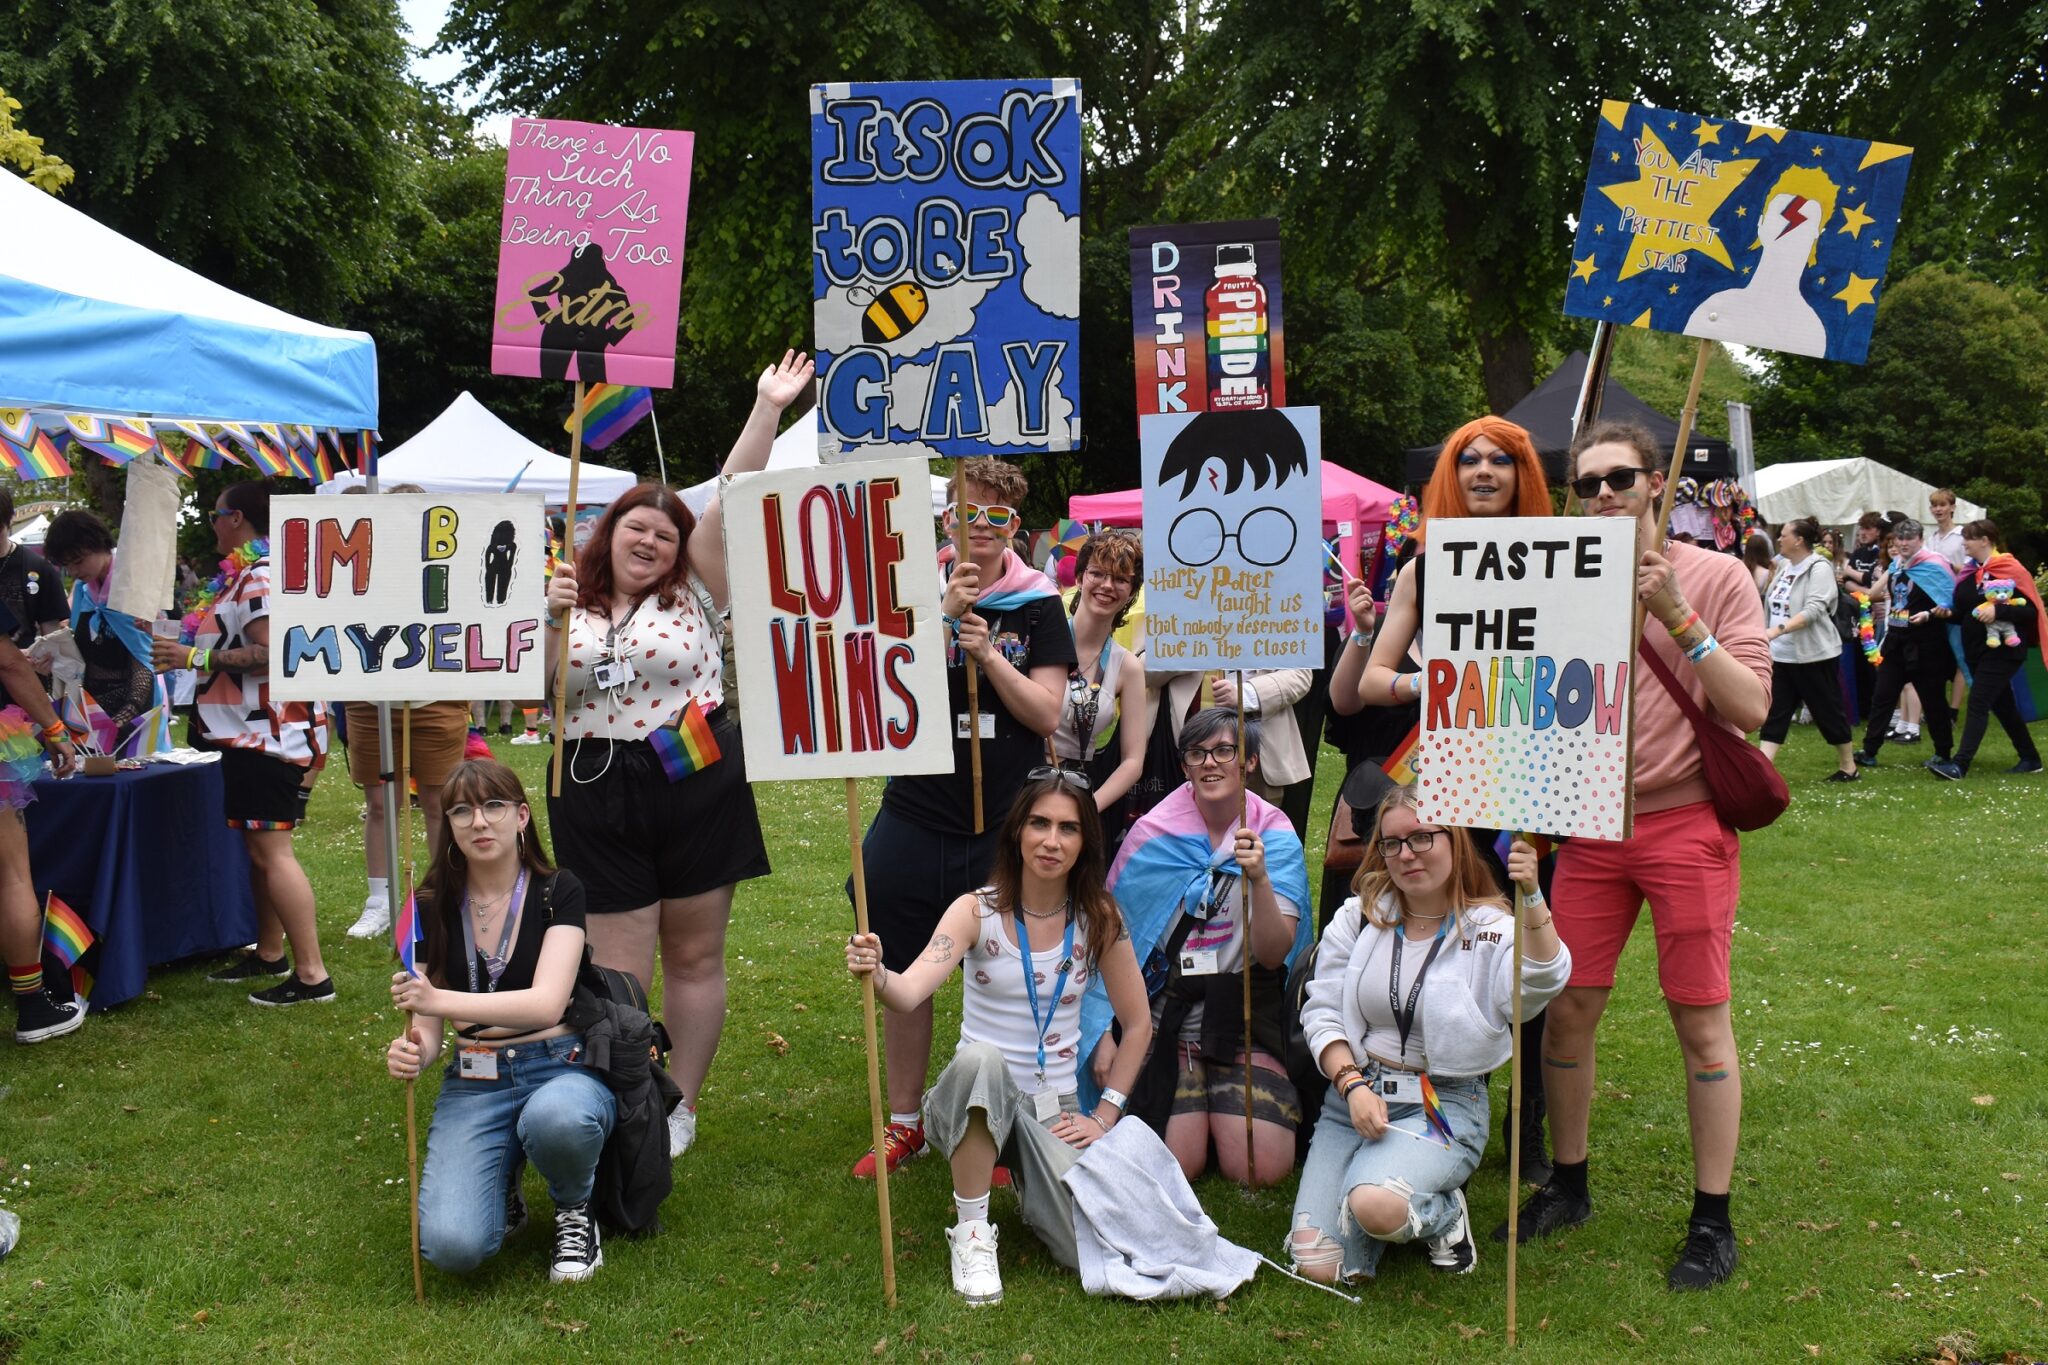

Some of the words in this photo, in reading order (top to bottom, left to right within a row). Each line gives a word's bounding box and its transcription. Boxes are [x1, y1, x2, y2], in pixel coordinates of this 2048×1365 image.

[515, 122, 608, 155] There's
[611, 132, 672, 164] No
[951, 88, 1067, 191] OK
[1633, 138, 1672, 170] YOU
[1678, 148, 1722, 179] ARE
[547, 151, 635, 189] Such
[1651, 175, 1699, 207] THE
[506, 176, 592, 219] Thing
[596, 189, 661, 225] As
[501, 216, 592, 258] Being
[604, 228, 673, 266] Too
[812, 208, 911, 288] to
[913, 195, 1017, 289] BE
[1618, 205, 1720, 244] PRETTIEST
[1638, 248, 1688, 273] STAR
[497, 271, 655, 332] Extra
[1223, 281, 1250, 290] FRUITY
[1151, 241, 1188, 413] DRINK
[1218, 291, 1258, 396] PRIDE
[821, 340, 1068, 444] GAY
[281, 517, 373, 598] IM
[421, 505, 459, 614] BI
[762, 476, 914, 640] LOVE
[1442, 536, 1603, 581] TASTE
[1149, 567, 1206, 600] Harry
[1210, 565, 1275, 604] Potter
[1217, 591, 1271, 620] taught
[1280, 593, 1302, 612] us
[283, 618, 539, 678] MYSELF
[1146, 613, 1178, 636] that
[1183, 615, 1233, 640] nobody
[1236, 615, 1299, 635] deserves
[1304, 617, 1319, 633] to
[1192, 640, 1208, 657] in
[1216, 636, 1242, 659] the
[1435, 607, 1537, 651] THE
[1426, 655, 1628, 735] RAINBOW
[469, 961, 478, 991] STUDENT
[1392, 962, 1400, 993] Canterbury
[1407, 982, 1421, 1012] STUDENT
